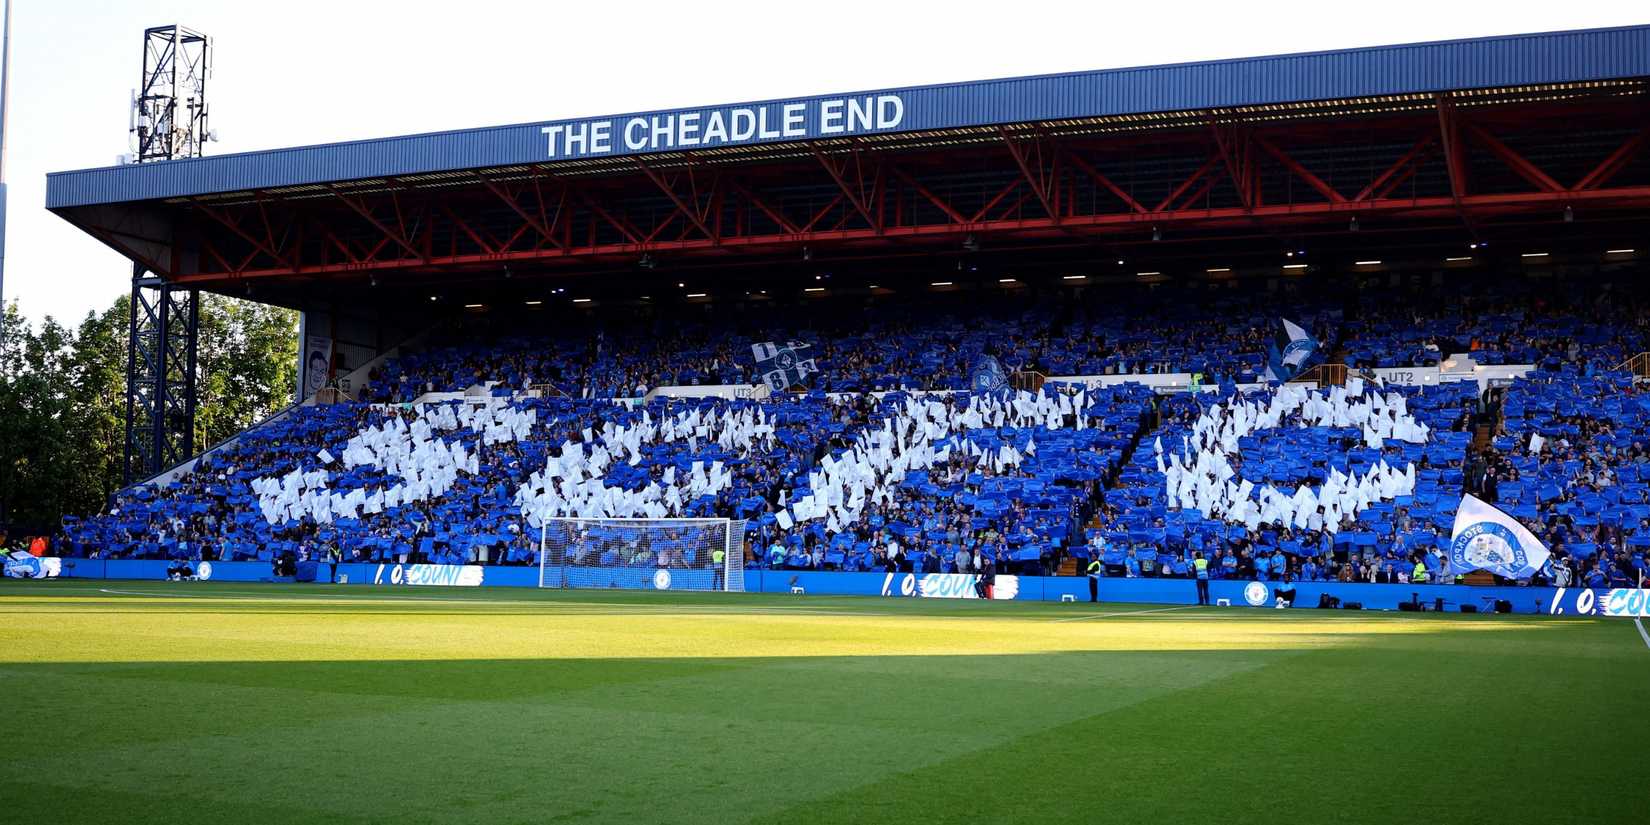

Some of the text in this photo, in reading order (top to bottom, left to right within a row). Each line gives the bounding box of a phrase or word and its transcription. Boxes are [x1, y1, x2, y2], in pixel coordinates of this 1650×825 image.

[541, 95, 904, 157] THE CHEADLE END
[1389, 371, 1414, 383] UT2
[1609, 589, 1650, 614] CO
